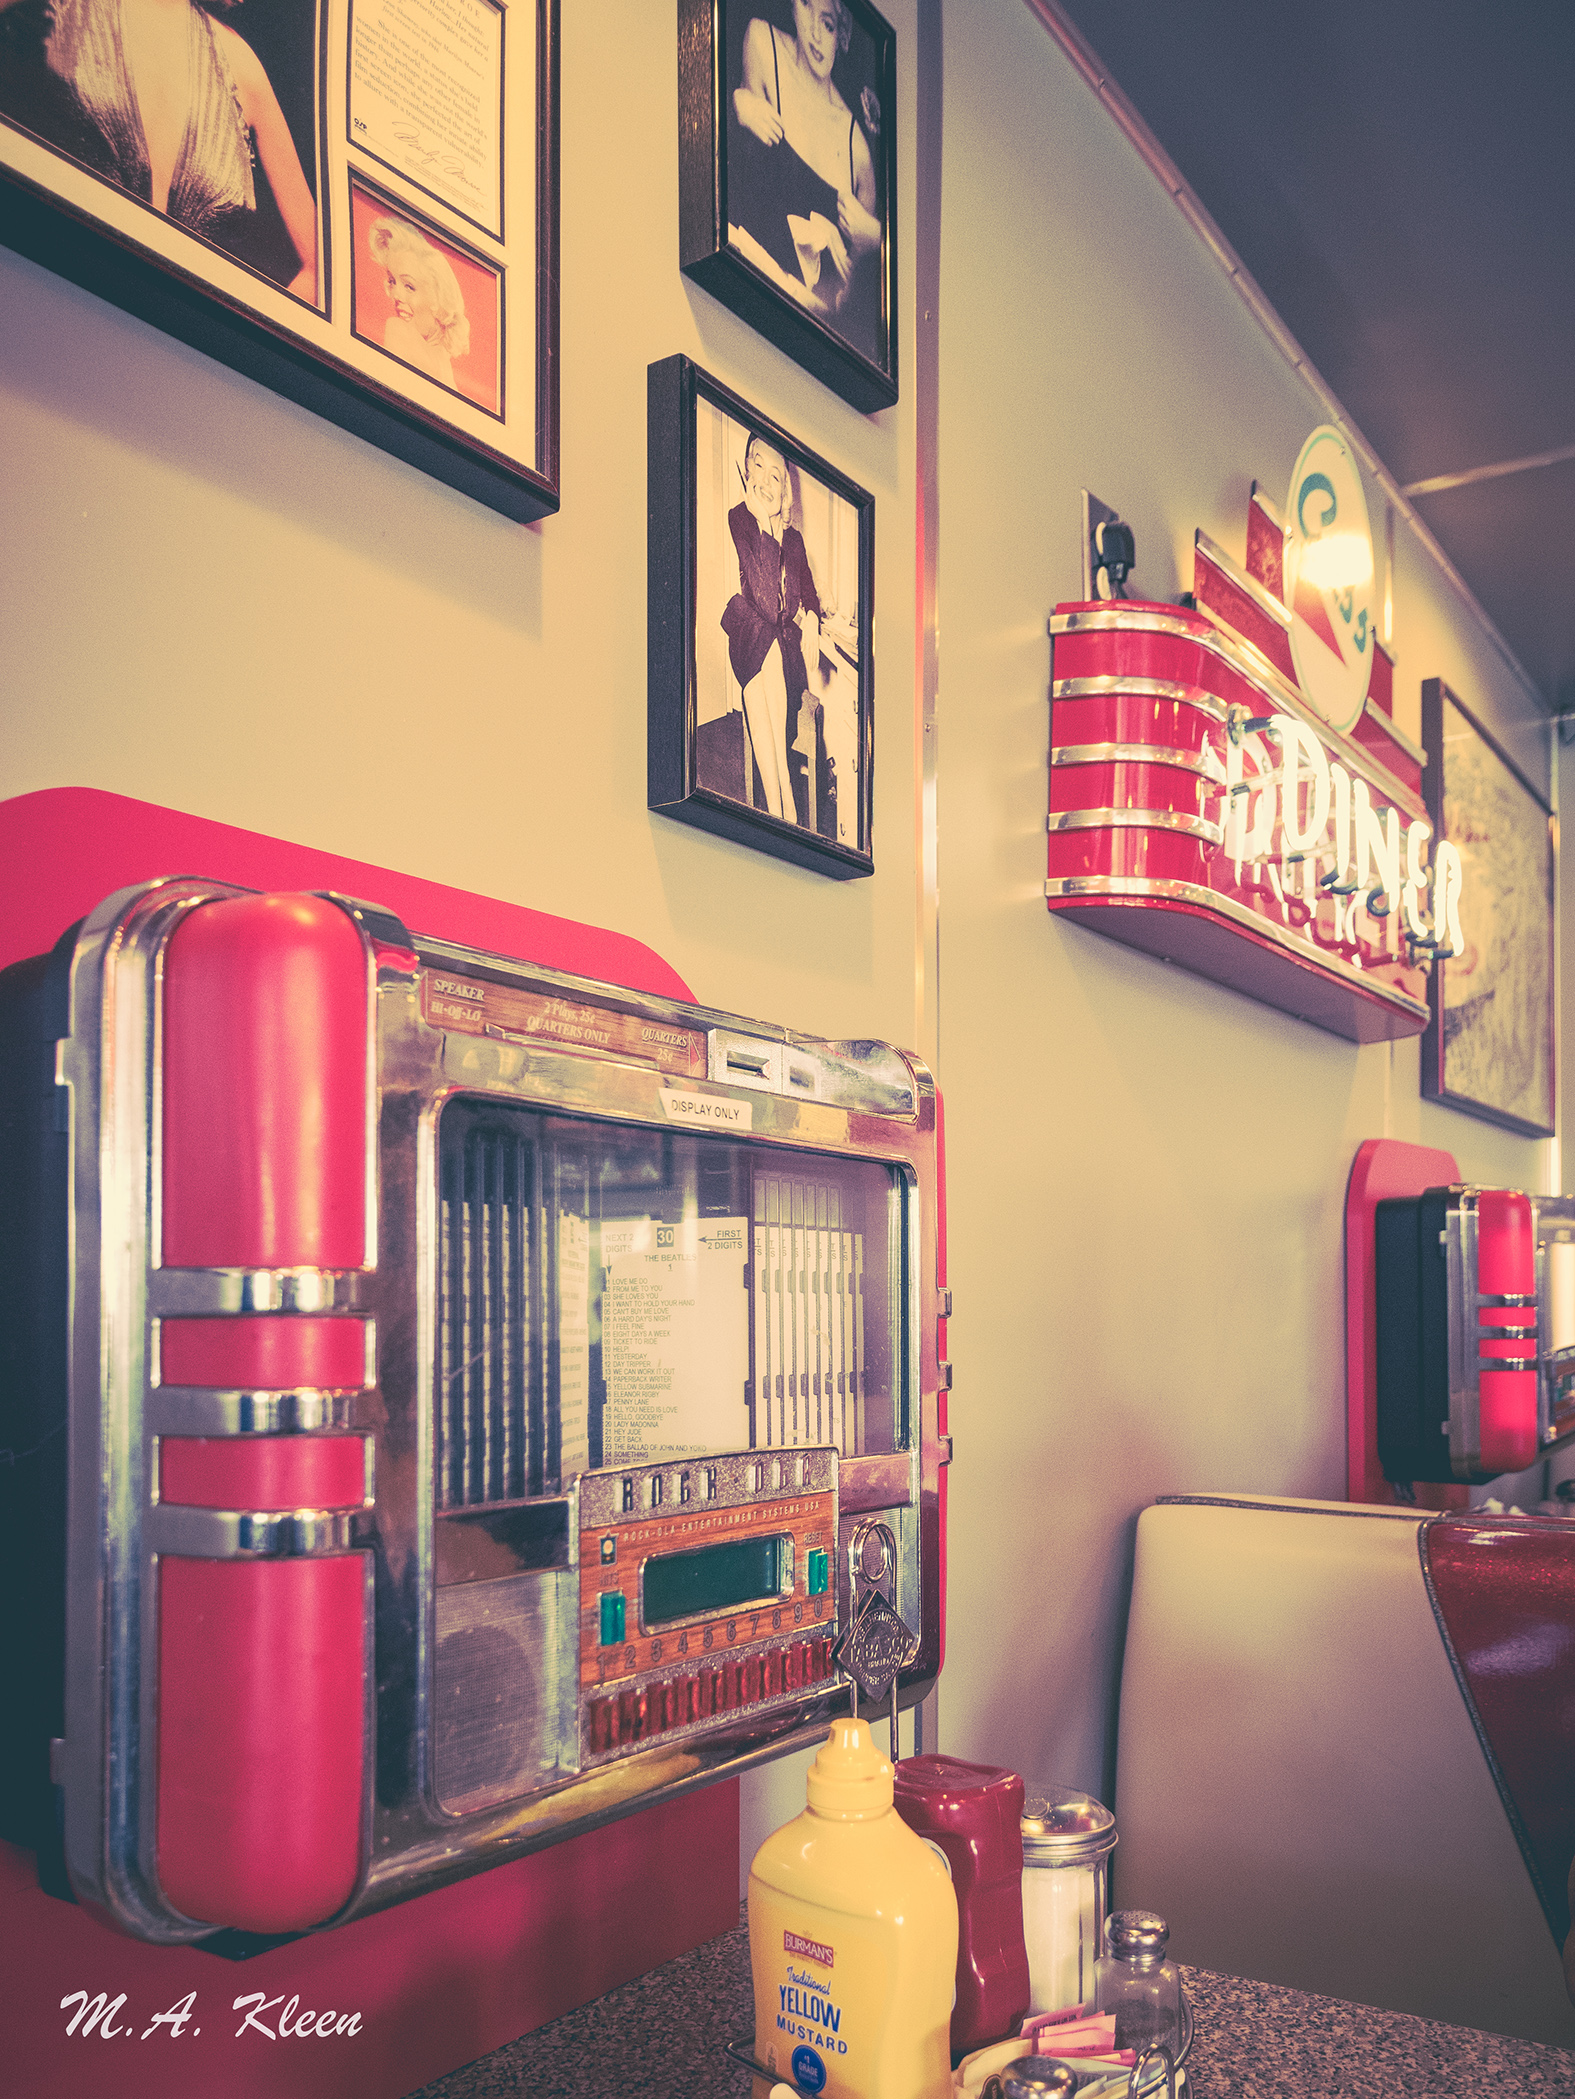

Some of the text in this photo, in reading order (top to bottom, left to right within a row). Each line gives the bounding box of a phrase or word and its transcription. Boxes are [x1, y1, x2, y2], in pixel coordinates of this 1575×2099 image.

[434, 979, 485, 1001] SPEAKER
[544, 1000, 595, 1023] 2 Plays, 25¢
[527, 1016, 610, 1044] QUARTERS ONLY
[642, 1027, 687, 1047] QUARTERS
[657, 1047, 672, 1063] 25¢
[672, 1100, 739, 1120] DISPLAY ONLY
[657, 1230, 674, 1244] 30
[715, 1241, 743, 1249] DIGITS
[624, 1502, 820, 1542] ROCK-OLA ENTERTAINMENT SYSTEMS USA
[804, 1531, 823, 1544] RESET
[625, 1645, 636, 1669] 2
[652, 1639, 663, 1662] 3
[678, 1632, 688, 1654] 4
[703, 1626, 713, 1648] 5
[726, 1619, 736, 1641] 6
[750, 1614, 761, 1635] 7
[772, 1608, 781, 1629] 8
[794, 1602, 803, 1623] 9
[814, 1598, 822, 1618] 0
[785, 1933, 833, 1964] BURMAN'S
[787, 1966, 831, 1995] Traditional
[779, 1985, 841, 2033] YELLOW
[777, 2014, 847, 2054] MUSTARD
[799, 2061, 818, 2077] GRADE
